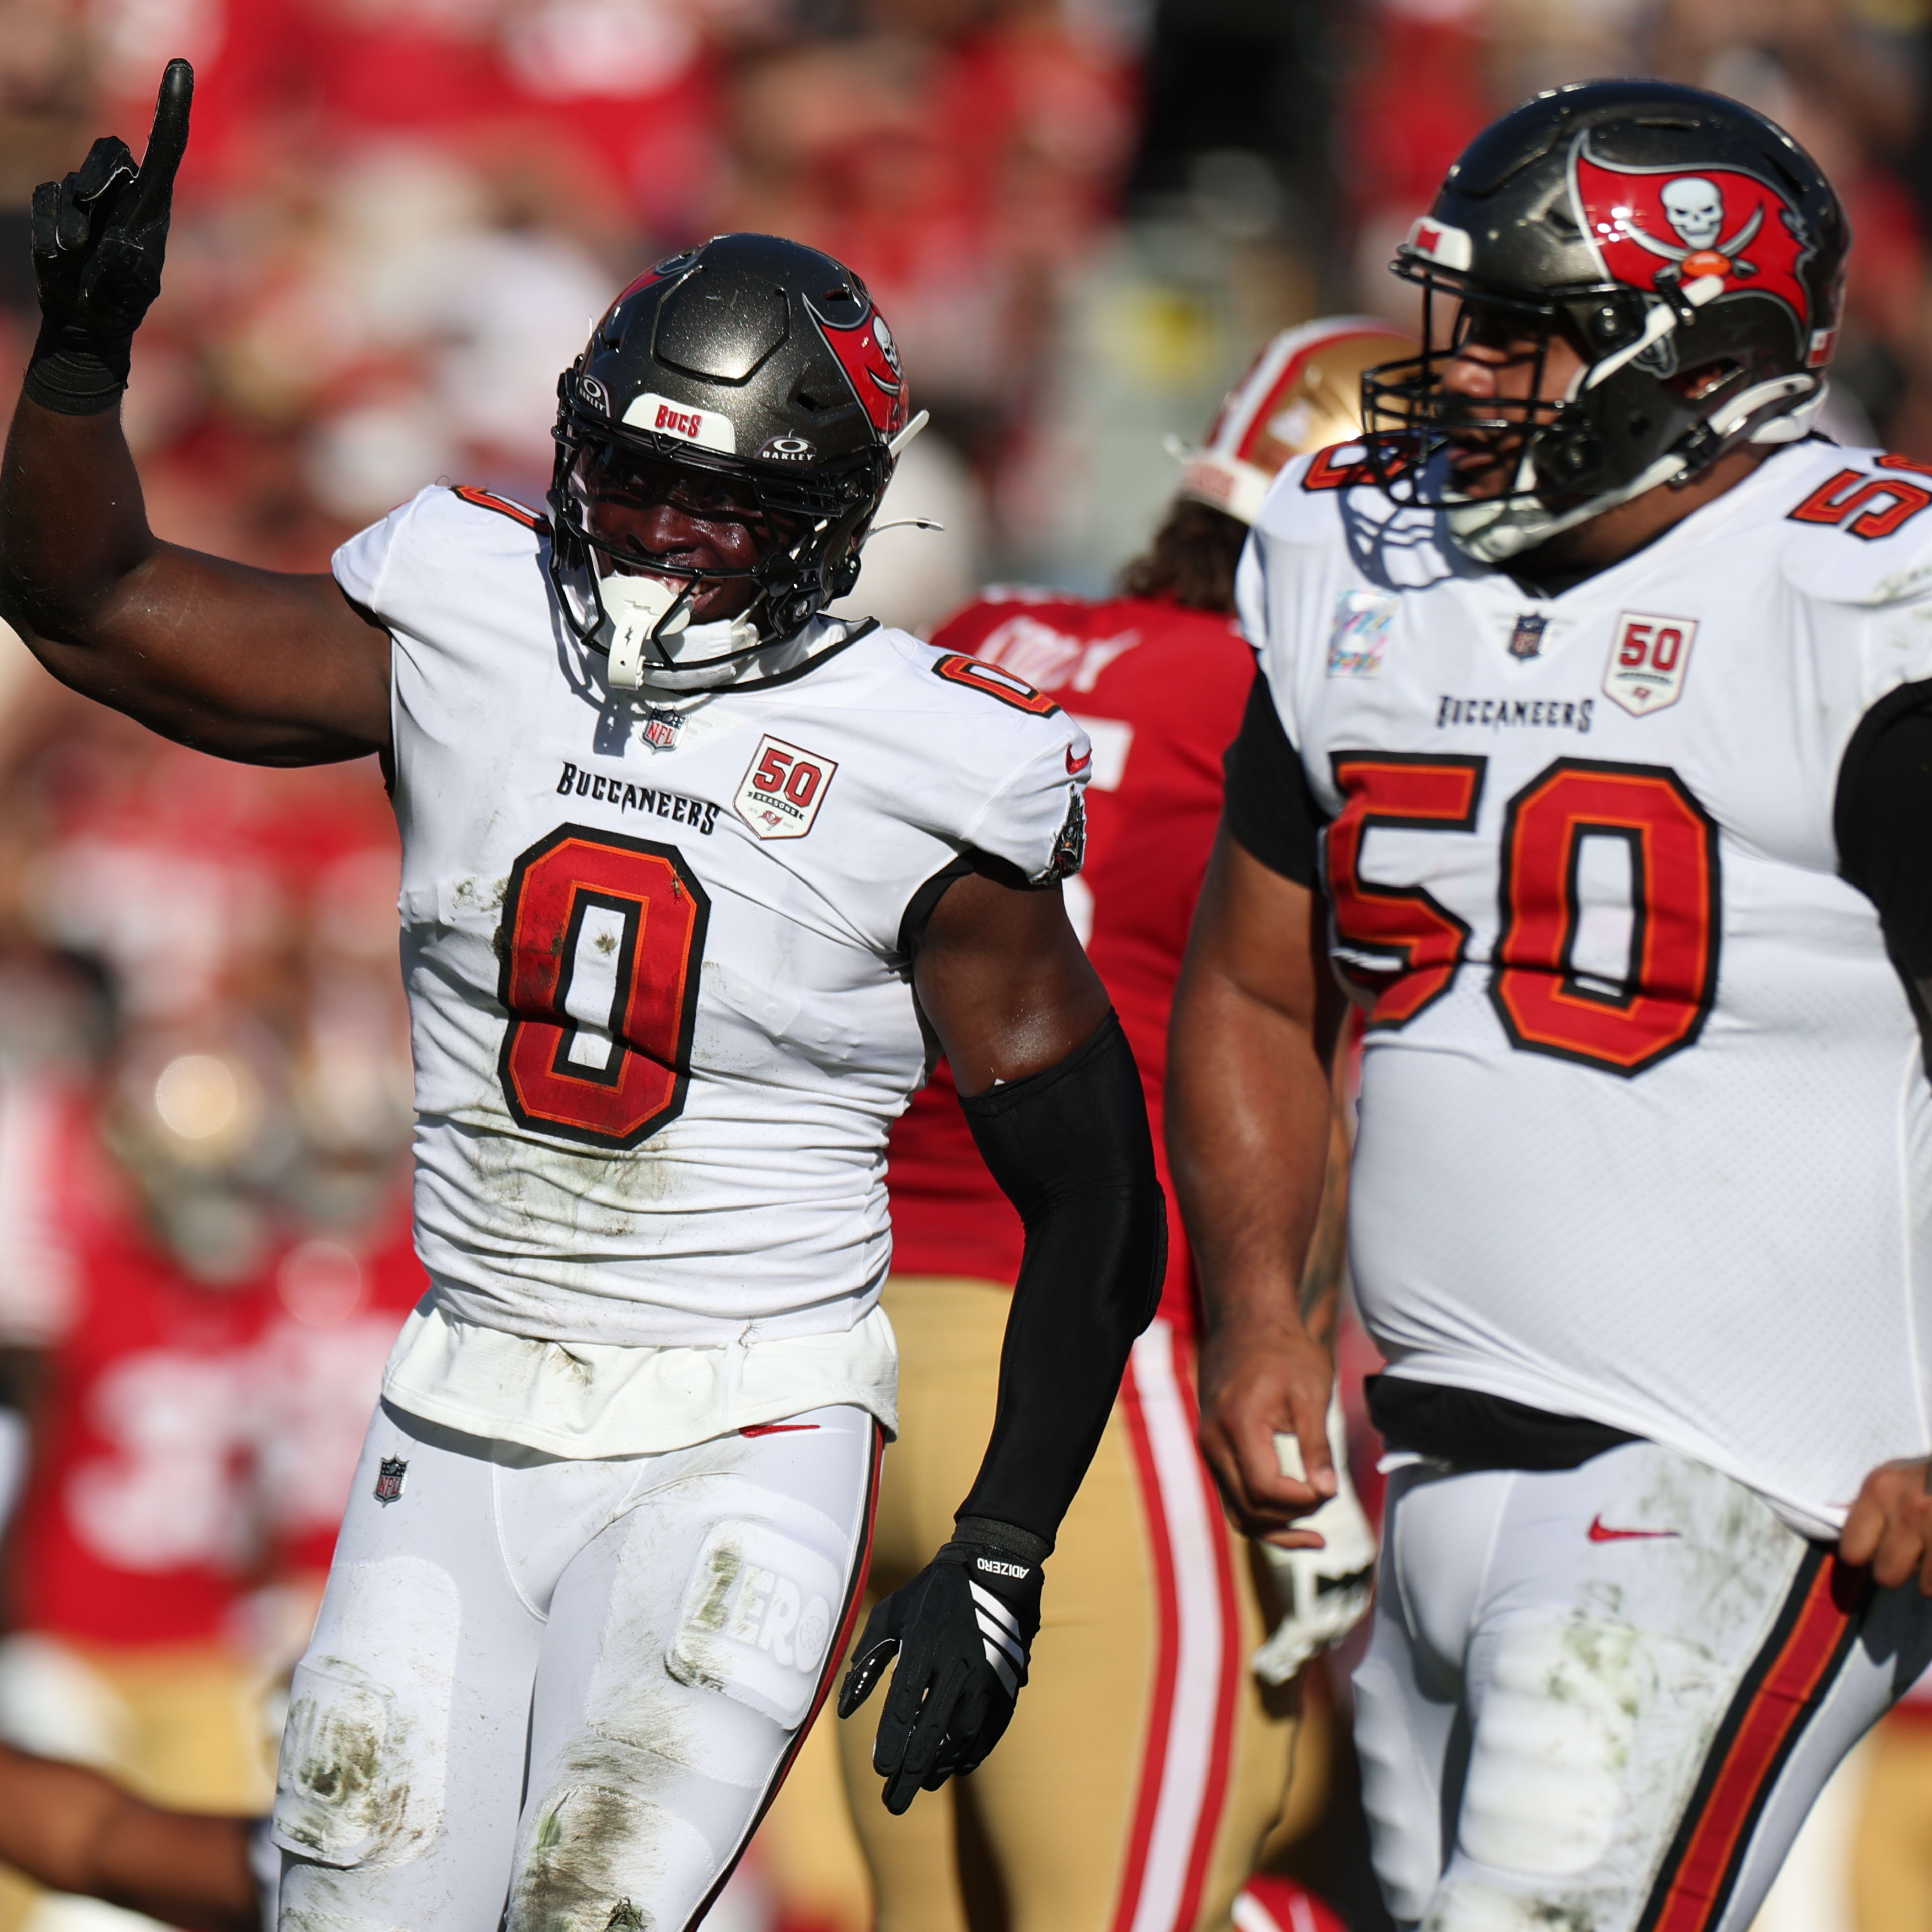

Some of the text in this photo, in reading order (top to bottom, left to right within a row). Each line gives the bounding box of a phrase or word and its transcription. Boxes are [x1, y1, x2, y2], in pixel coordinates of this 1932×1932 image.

[655, 404, 702, 438] BUCS
[762, 450, 815, 461] OAKLEY
[1620, 623, 1682, 671] 50
[931, 654, 1062, 719] 0
[646, 721, 673, 744] NFL
[1436, 695, 1594, 733] BUCCANEERS
[752, 747, 821, 808] 50
[556, 760, 721, 836] BUCCANEERS
[755, 793, 797, 816] SEASONS
[1326, 750, 1722, 1080] 50
[497, 822, 711, 1150] 0
[378, 1476, 400, 1496] NFL
[977, 1557, 1030, 1579] ADIZERO
